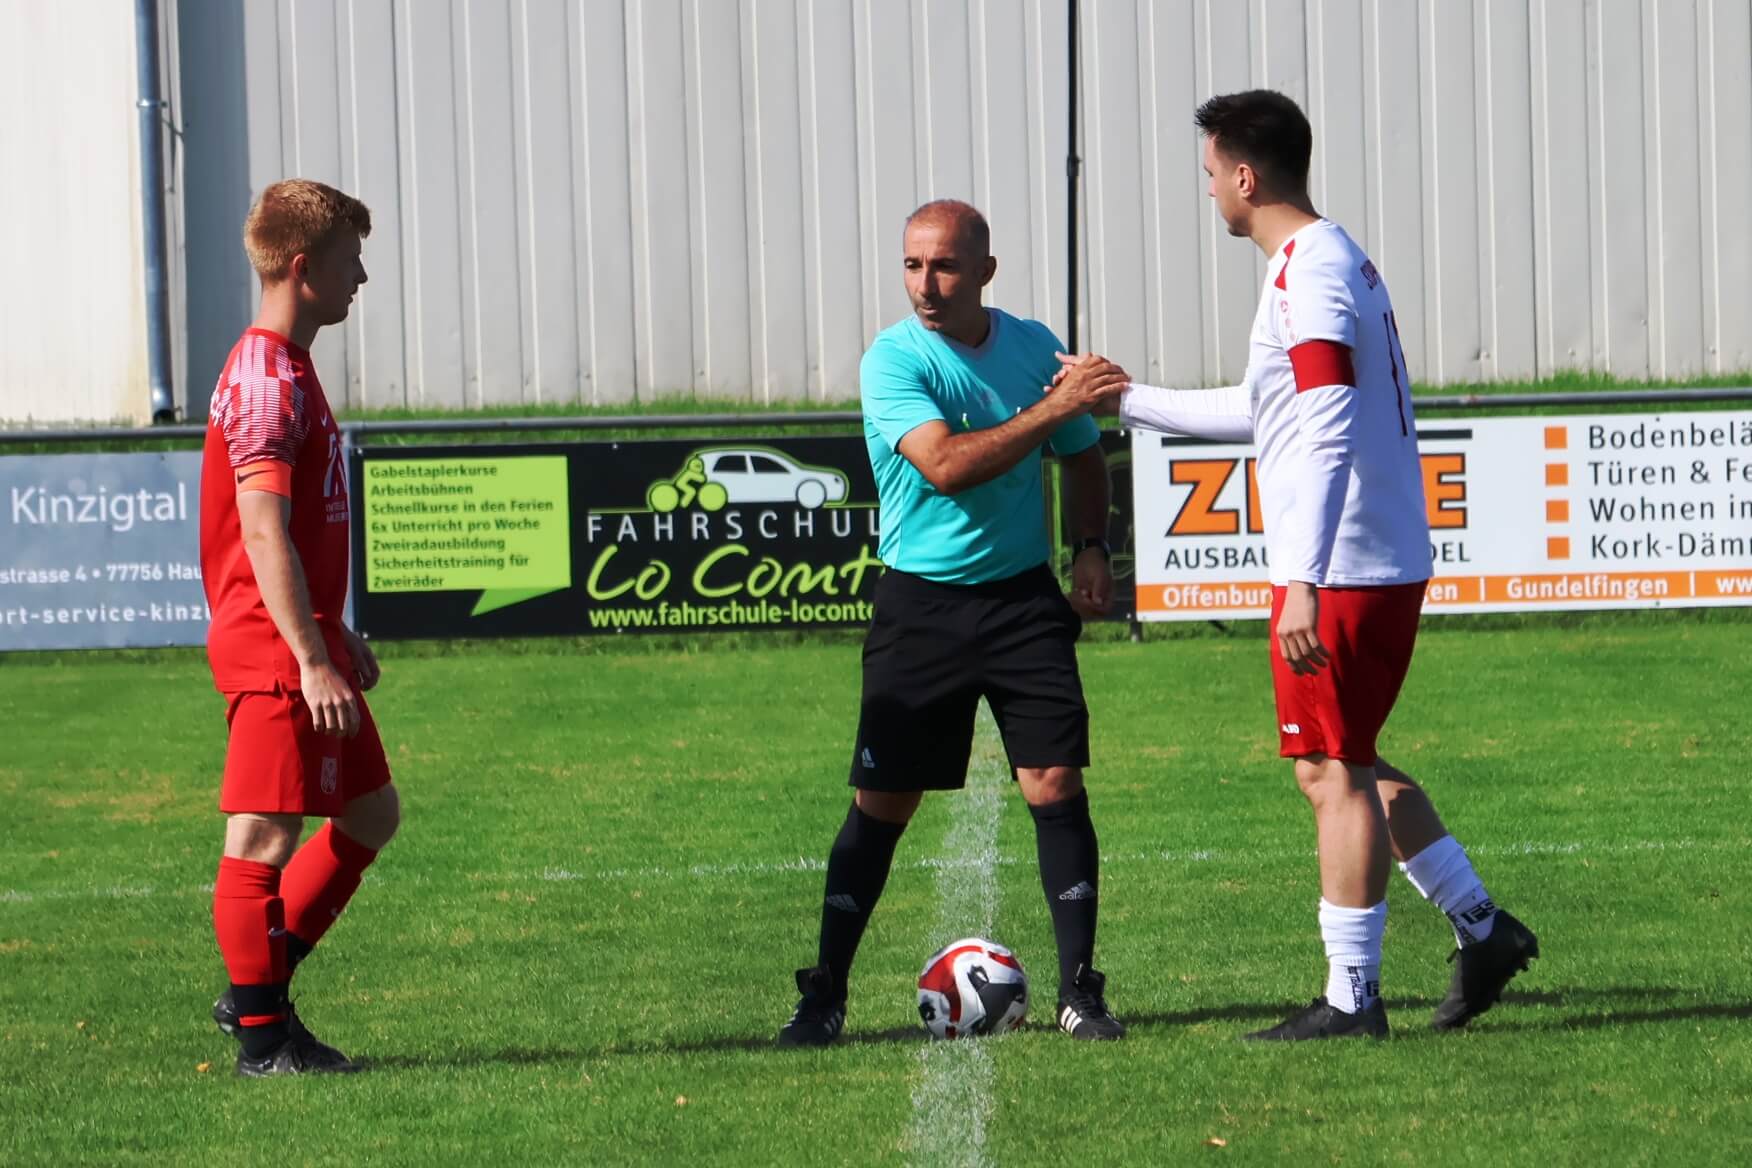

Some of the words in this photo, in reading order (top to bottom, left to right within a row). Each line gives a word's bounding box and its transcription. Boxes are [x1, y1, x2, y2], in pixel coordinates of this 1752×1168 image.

[370, 465, 497, 480] Gabelstaplerkurse
[1587, 460, 1677, 487] Türen
[1690, 460, 1711, 485] &
[371, 484, 473, 496] Arbeitsbühnen
[11, 482, 187, 532] Kinzigtal
[371, 501, 458, 515] Schnellkurse
[463, 500, 476, 513] in
[481, 500, 506, 512] den
[510, 499, 554, 511] Ferien
[1588, 496, 1715, 523] Wohnen
[371, 521, 387, 534] 6x
[392, 519, 463, 532] Unterricht
[468, 520, 491, 534] pro
[494, 518, 541, 530] Woche
[372, 538, 506, 553] Zweiradausbildung
[1591, 531, 1752, 559] Kork-Däm
[373, 556, 505, 571] Sicherheitstraining
[509, 554, 529, 567] für
[586, 544, 671, 601] Lo
[692, 543, 886, 598] Cont
[75, 565, 87, 582] 4
[106, 563, 163, 582] 77756
[373, 576, 444, 588] Zweiräder
[1162, 583, 1273, 609] Offenbur
[1506, 575, 1668, 600] Gundelfingen
